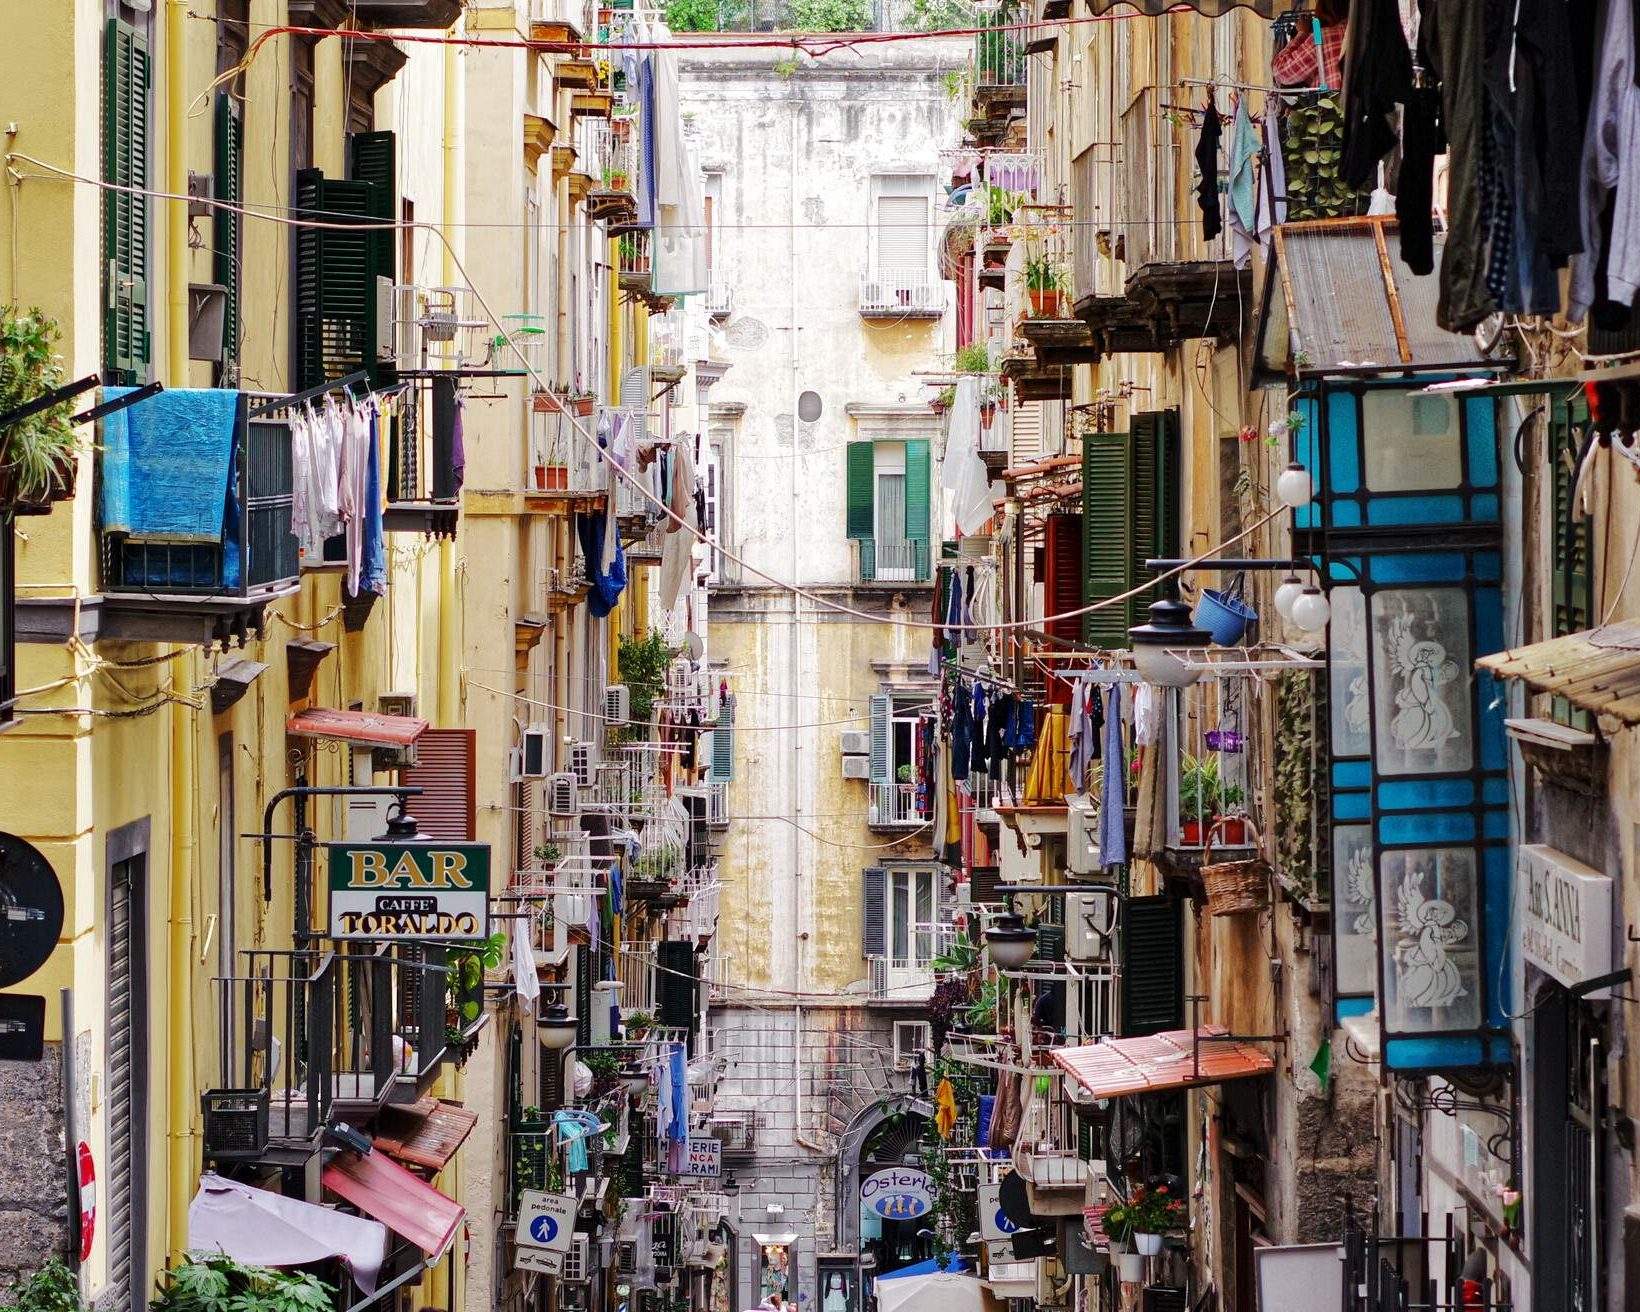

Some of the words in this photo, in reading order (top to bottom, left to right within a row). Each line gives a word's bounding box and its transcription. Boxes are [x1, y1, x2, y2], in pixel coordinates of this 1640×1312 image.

[347, 850, 473, 888] BAR
[338, 911, 480, 935] TORALDO
[660, 1140, 719, 1154] MERIE
[862, 1172, 938, 1198] Osteria
[531, 1203, 567, 1215] pedonale
[542, 1196, 559, 1205] area
